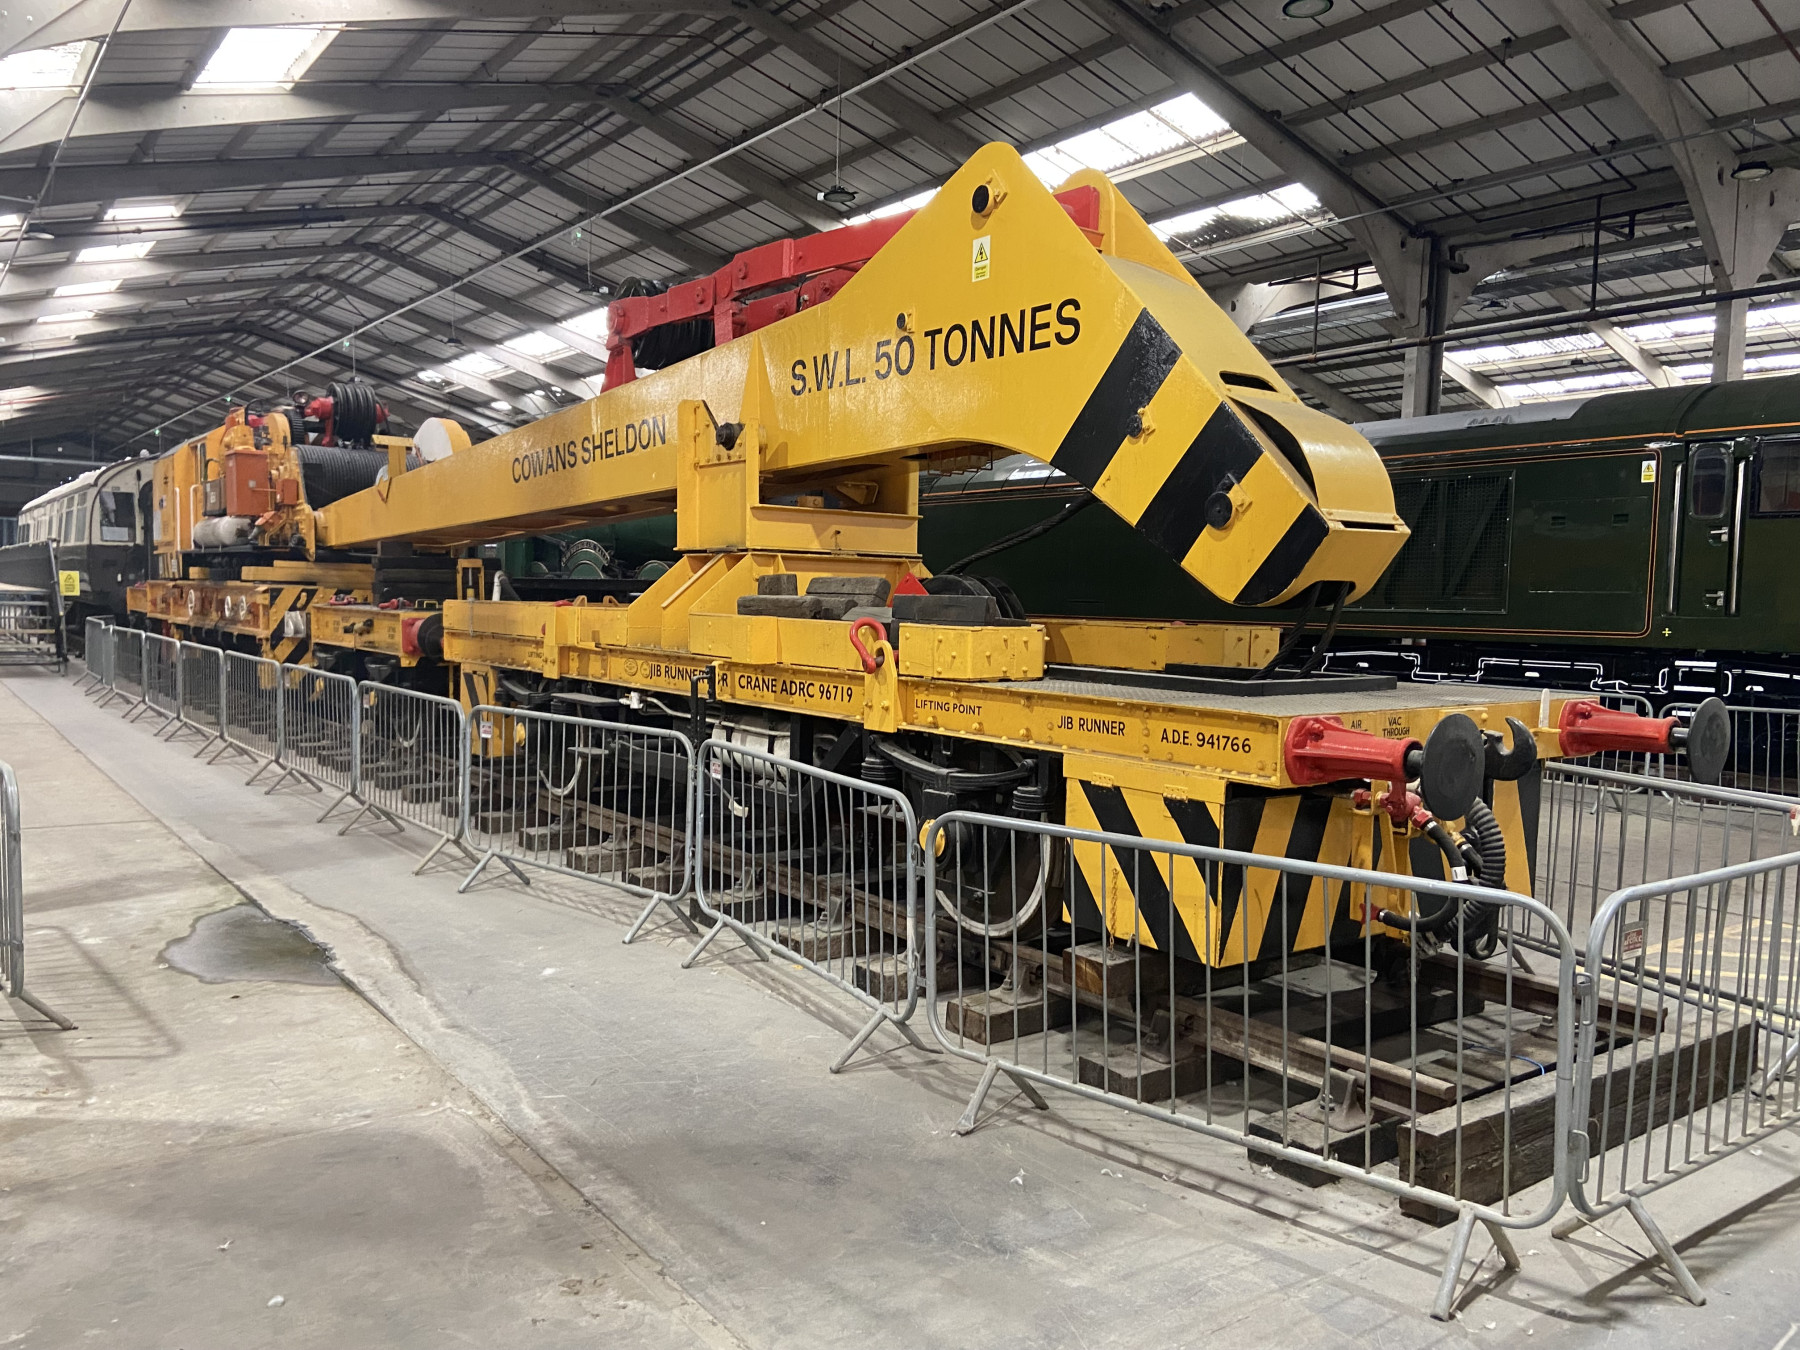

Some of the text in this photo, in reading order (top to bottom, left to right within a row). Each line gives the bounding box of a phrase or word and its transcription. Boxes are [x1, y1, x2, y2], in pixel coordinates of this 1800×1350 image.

[791, 298, 1081, 396] S.W.L. 50 TONNES
[512, 414, 667, 483] COWANS SHELDON
[650, 663, 662, 679] JIB
[738, 674, 777, 694] CRANE
[780, 679, 815, 699] ADRC
[818, 684, 853, 703] 96719
[915, 699, 983, 717] LIFTING POINT
[1057, 715, 1126, 737] JIB RUNNER
[1350, 719, 1362, 730] AIR
[1387, 716, 1402, 727] VAC
[1160, 728, 1252, 754] A.D.E. 941766
[1382, 727, 1410, 738] THROUGH
